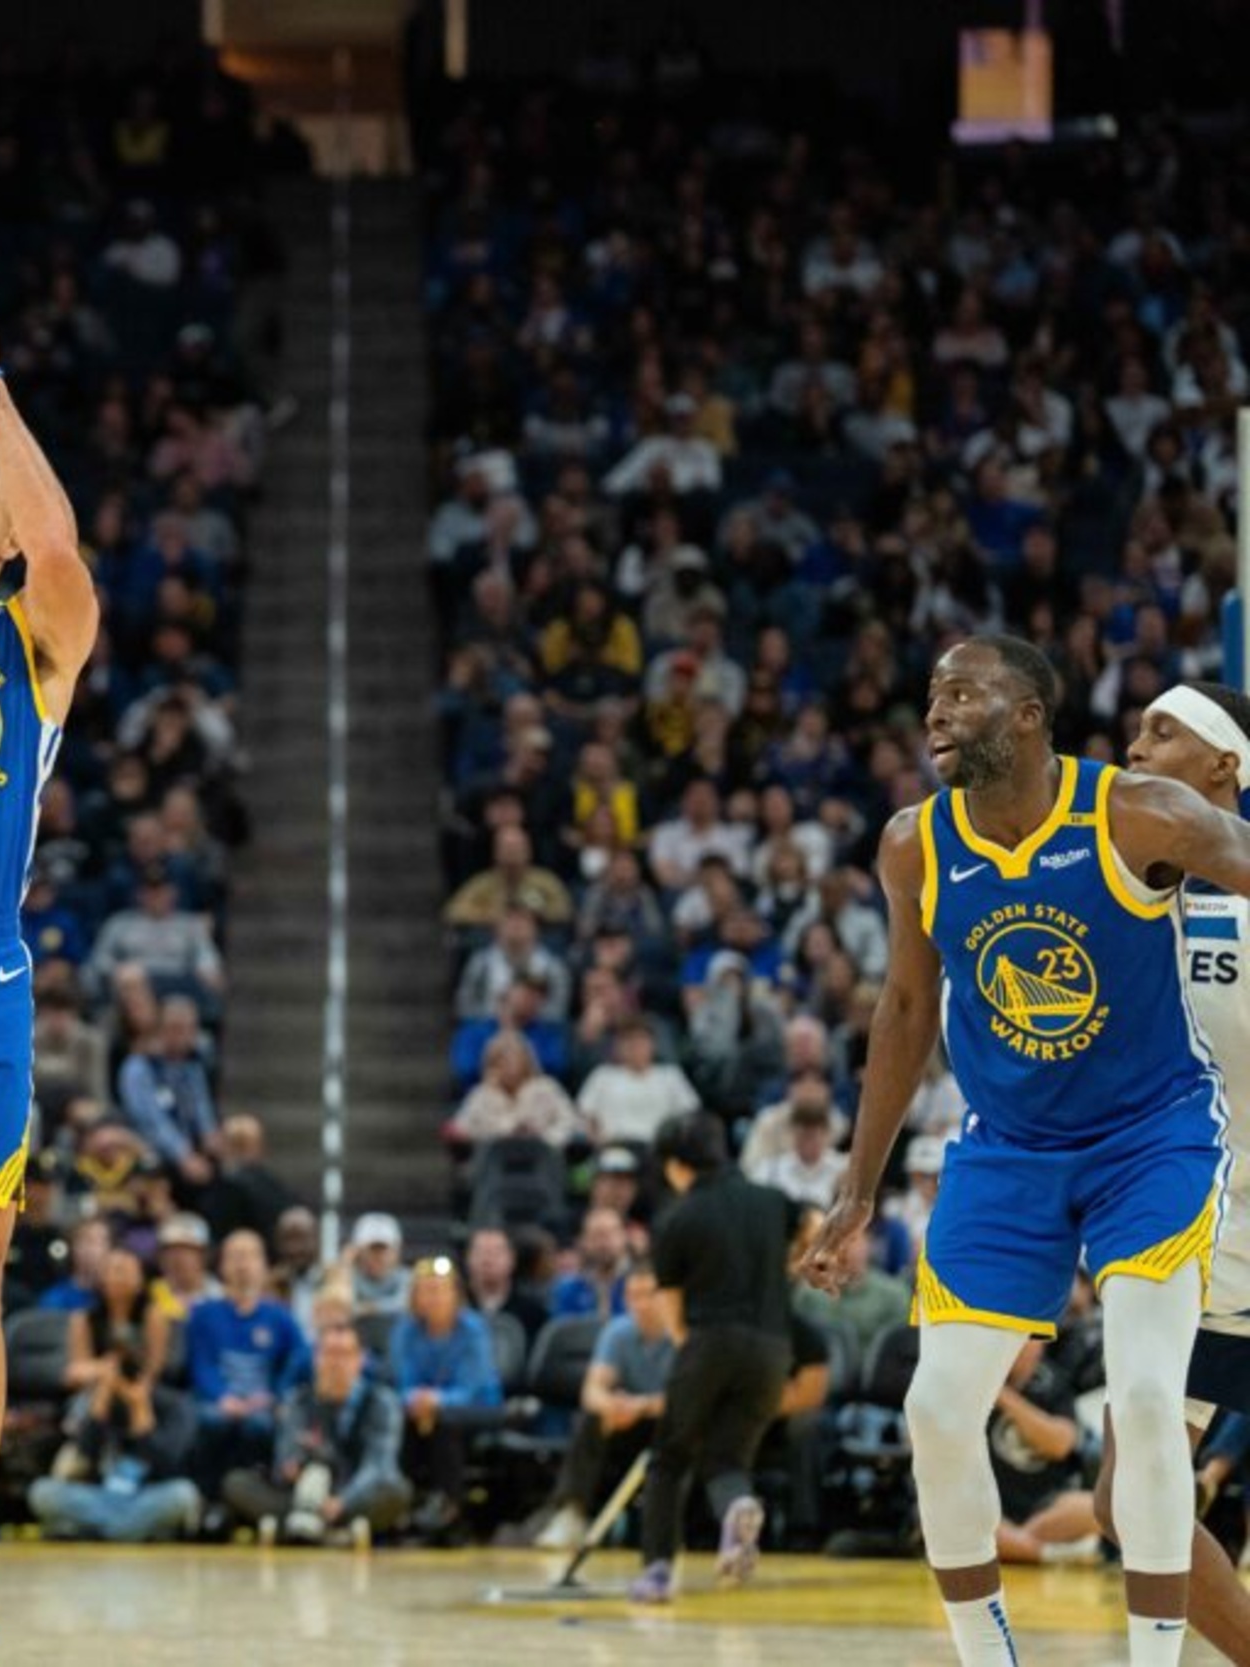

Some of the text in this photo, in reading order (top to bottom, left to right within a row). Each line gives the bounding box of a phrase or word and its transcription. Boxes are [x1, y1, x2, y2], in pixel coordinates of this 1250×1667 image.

[964, 903, 1089, 951] GOLDEN STATE
[1037, 945, 1081, 981] 23
[1187, 950, 1239, 985] ES
[990, 1004, 1110, 1061] WARRIORS
